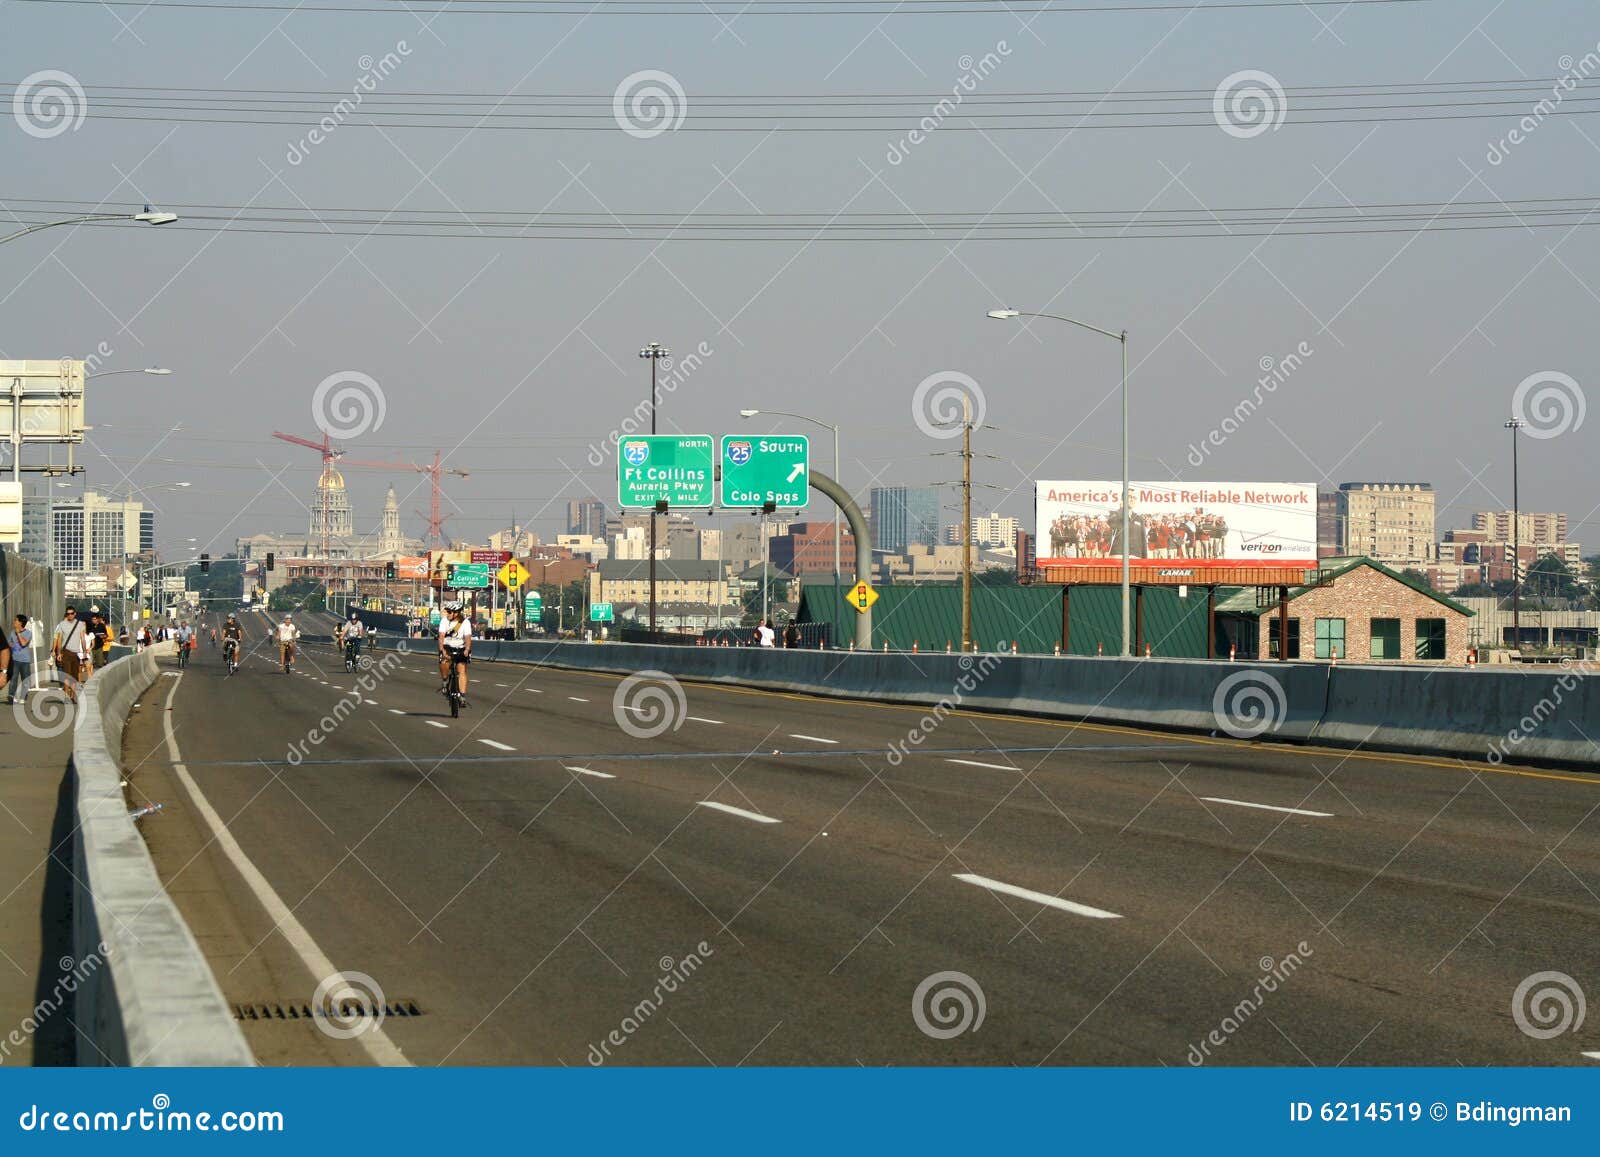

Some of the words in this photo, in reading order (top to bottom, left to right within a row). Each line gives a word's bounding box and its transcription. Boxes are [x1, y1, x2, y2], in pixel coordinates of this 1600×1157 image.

[678, 440, 709, 448] NORTH
[759, 440, 803, 453] SOUTH
[628, 447, 646, 461] 25
[732, 447, 749, 461] 25
[625, 468, 642, 481] Ft
[647, 468, 705, 481] Collins
[628, 482, 669, 491] Auraria
[674, 482, 704, 493] Pkwy
[634, 494, 655, 502] EXIT
[677, 494, 699, 502] MILE
[731, 491, 760, 502] Colo
[766, 491, 799, 505] Spgs
[1048, 488, 1118, 503] America's
[1140, 489, 1177, 503] Most
[1180, 489, 1241, 504] Reliable
[1245, 490, 1309, 504] Network
[1240, 541, 1282, 554] verizon
